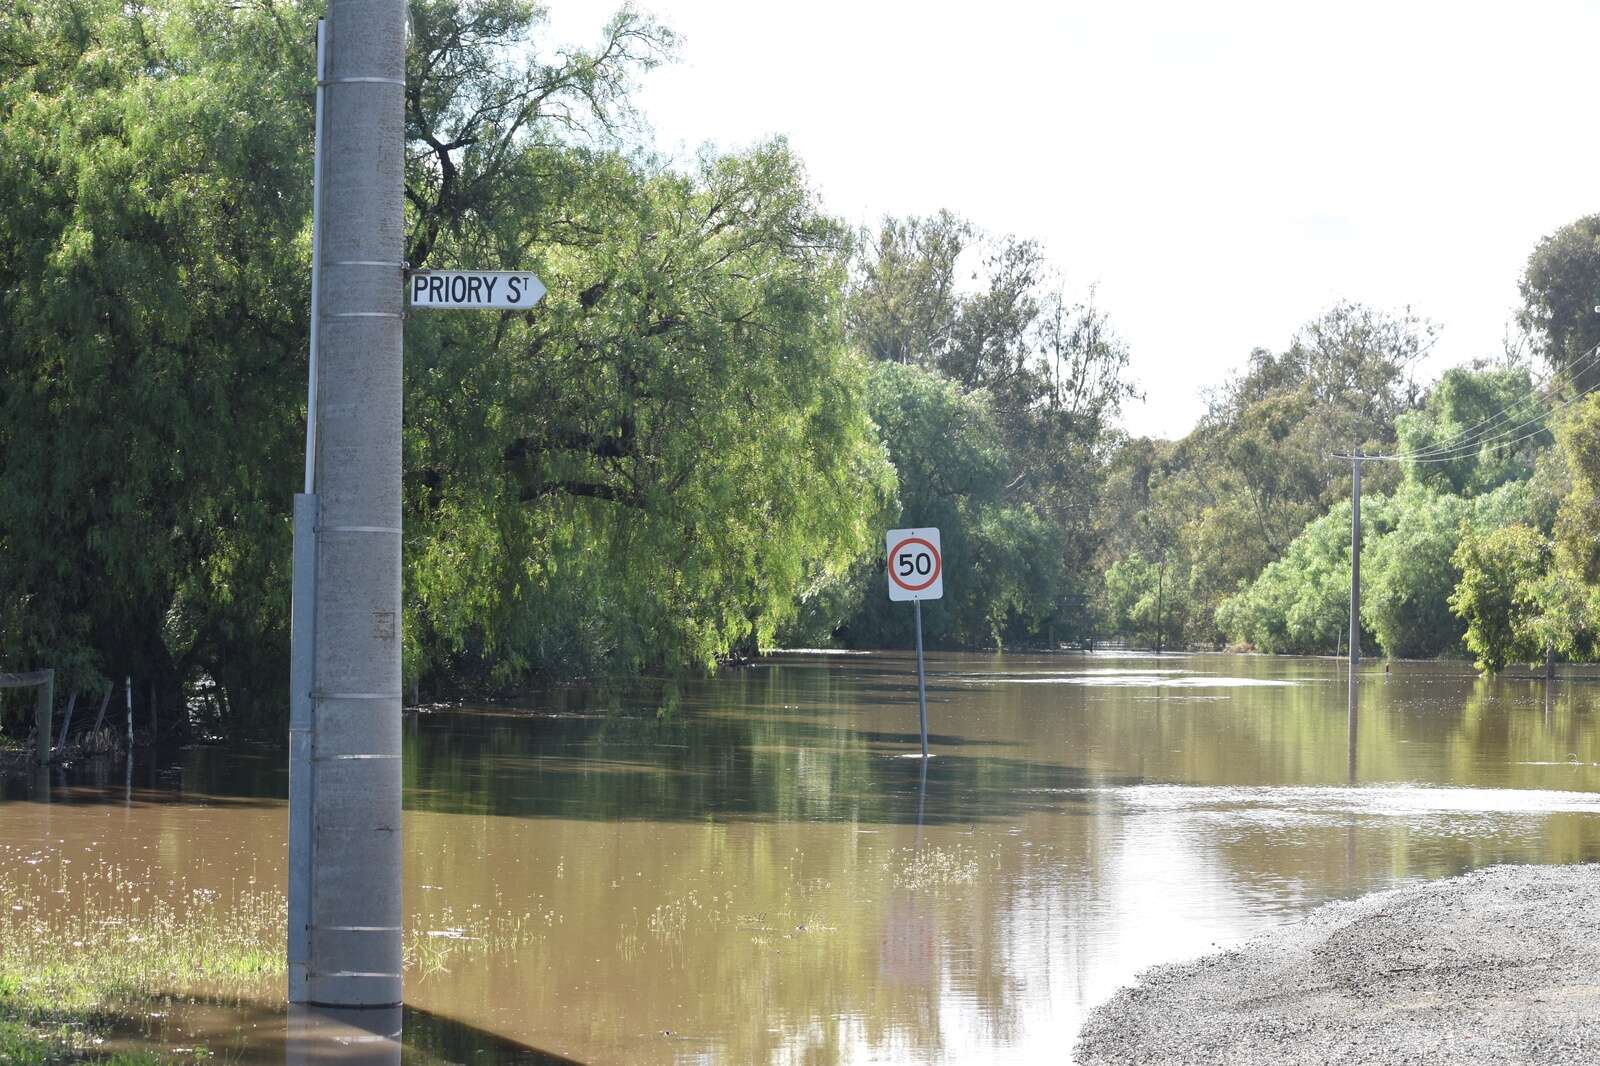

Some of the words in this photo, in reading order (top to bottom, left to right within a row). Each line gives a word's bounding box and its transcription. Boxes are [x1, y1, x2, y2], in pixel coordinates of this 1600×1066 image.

[413, 275, 498, 304] PRIORY
[506, 276, 530, 304] ST
[899, 552, 932, 577] 50
